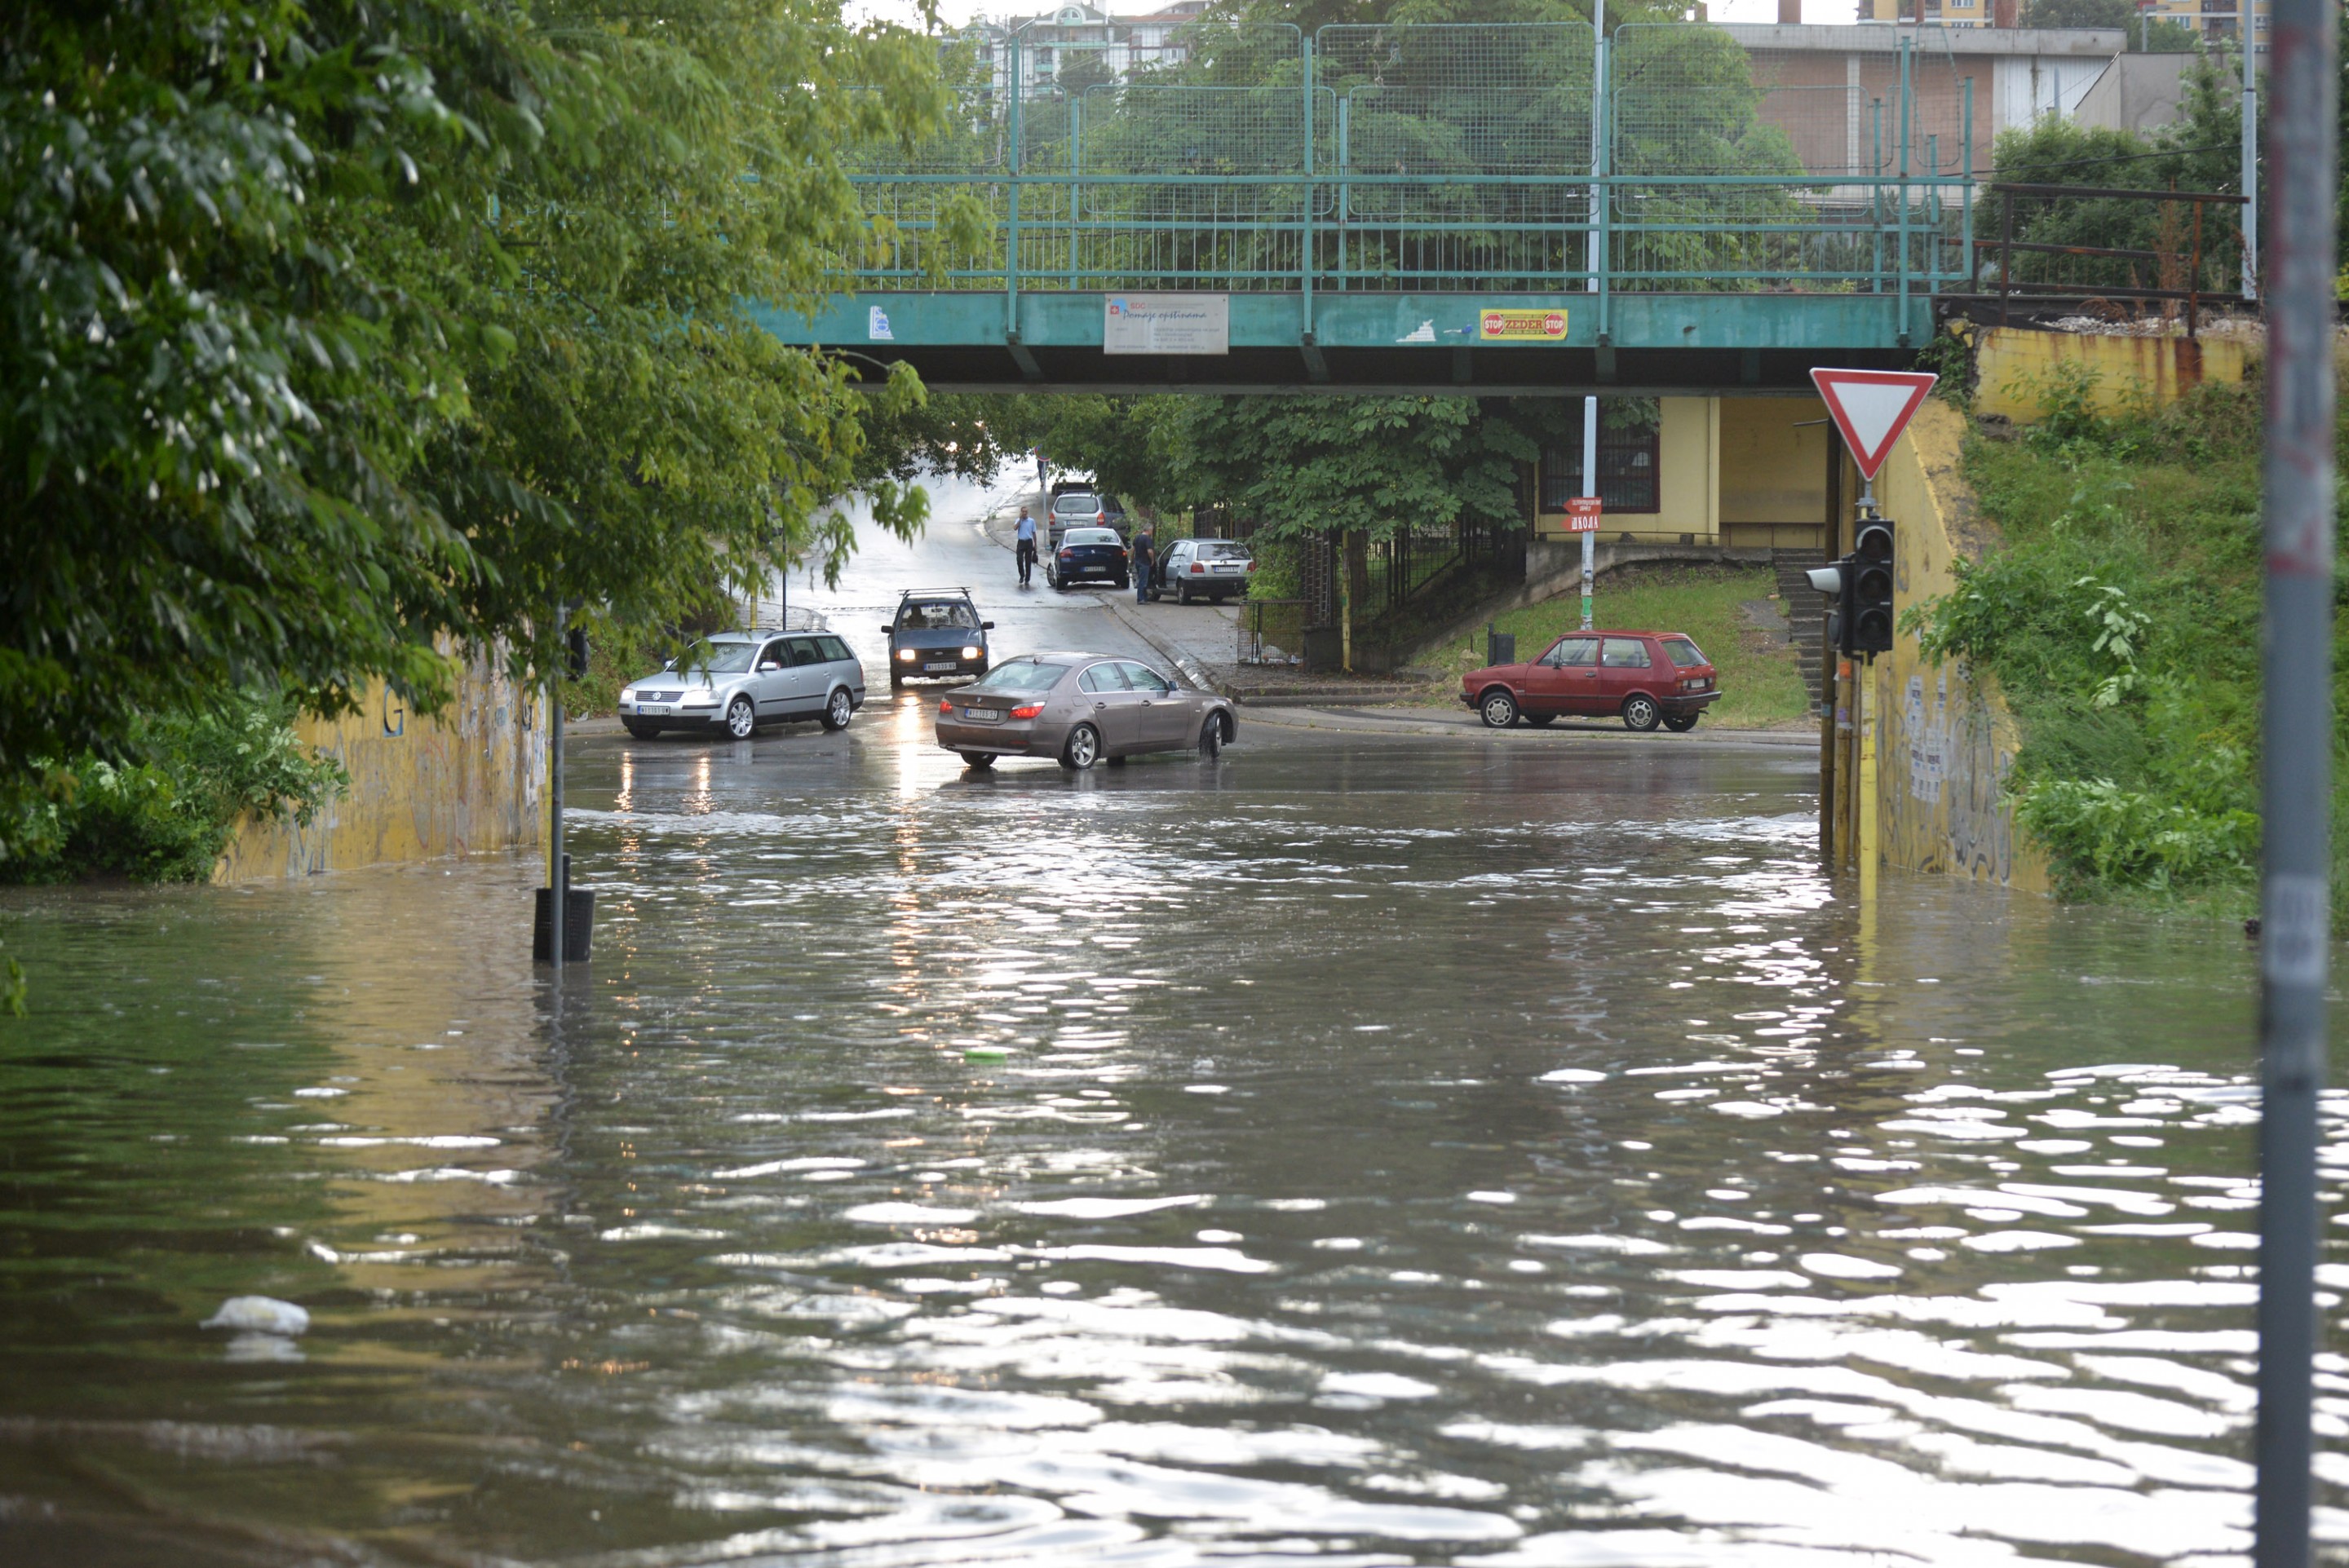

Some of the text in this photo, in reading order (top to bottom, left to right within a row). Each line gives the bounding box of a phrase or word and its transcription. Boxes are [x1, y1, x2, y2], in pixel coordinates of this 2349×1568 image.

[1484, 320, 1503, 329] STOP
[1546, 320, 1563, 329] STOP
[1571, 515, 1599, 530] ШКОЛА
